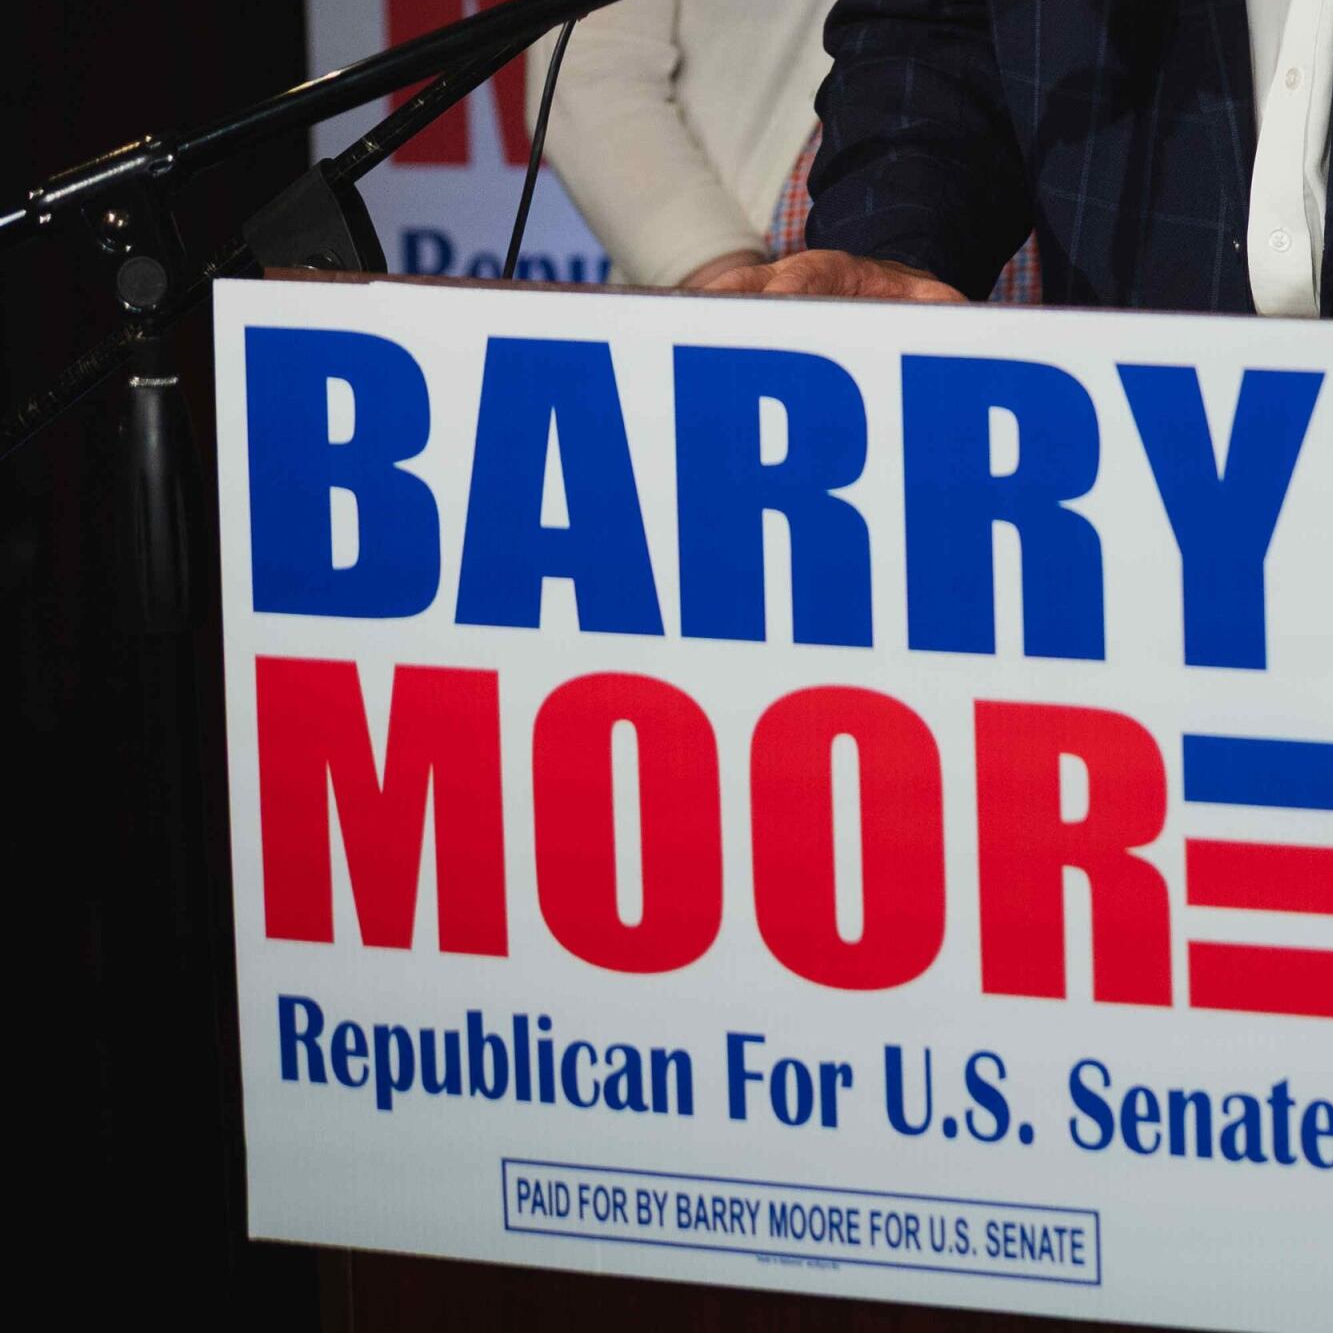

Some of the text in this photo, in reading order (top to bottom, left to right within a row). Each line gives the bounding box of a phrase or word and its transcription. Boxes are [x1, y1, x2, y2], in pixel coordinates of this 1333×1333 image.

[244, 325, 1326, 670] BARRY
[276, 994, 694, 1116] Republican
[726, 1030, 853, 1134] For
[883, 1046, 1036, 1147] U.S.
[516, 1178, 1086, 1265] PAID FOR BY BARRY MOORE FOR U.S. SENATE
